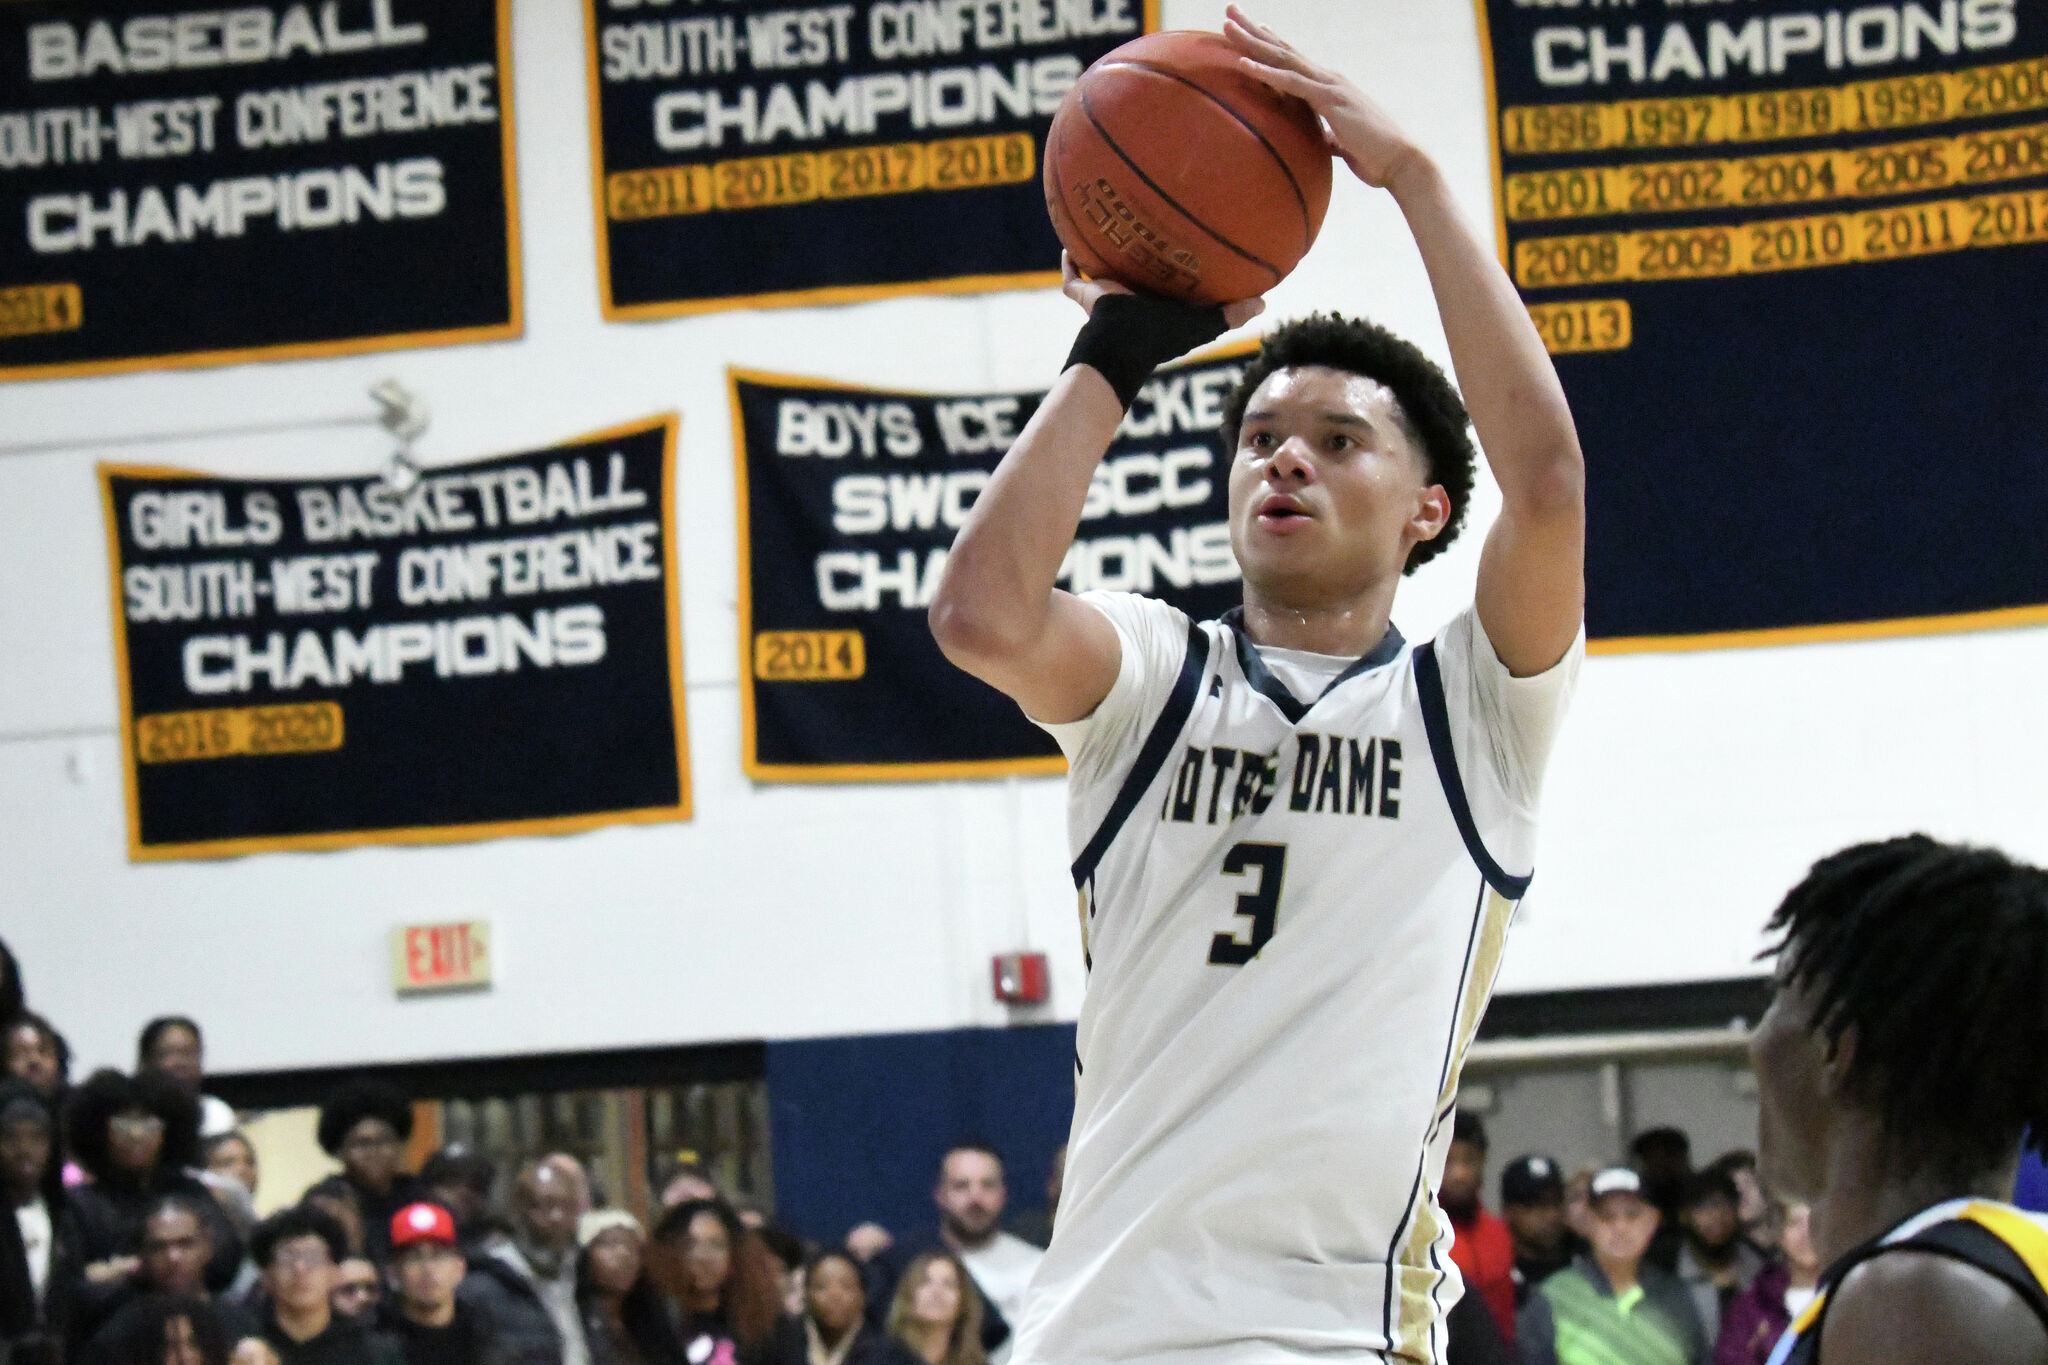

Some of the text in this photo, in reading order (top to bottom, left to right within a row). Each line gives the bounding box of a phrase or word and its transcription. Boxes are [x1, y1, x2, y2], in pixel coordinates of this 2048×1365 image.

[28, 0, 428, 80] BASEBALL
[602, 0, 1138, 81] SOUTH-WEST CONFERENCE
[1532, 0, 2017, 86] CHAMPIONS
[236, 63, 499, 148] CONFERENCE
[653, 55, 1084, 150] CHAMPIONS
[1513, 105, 1602, 148] 1996
[1624, 99, 1713, 143] 1997
[1856, 79, 1948, 128] 1999
[27, 157, 447, 253] CHAMPIONS
[614, 138, 1027, 214] 2011 2016 2017 2018
[1514, 172, 1608, 216] 2001
[1628, 162, 1725, 208] 2002
[1740, 155, 1838, 201] 2004
[1854, 142, 1948, 188] 2005
[1522, 238, 1620, 283] 2008
[1637, 228, 1733, 273] 2009
[1750, 219, 1844, 265] 2010
[1863, 208, 1956, 254] 2011
[775, 399, 922, 459] BOYS
[934, 395, 1019, 458] ICE
[129, 452, 648, 550] GIRLS BASKETBALL
[122, 521, 662, 622] SOUTH-WEST CONFERENCE
[182, 603, 607, 695] CHAMPIONS
[766, 635, 854, 674] 2014
[148, 710, 231, 754] 2016
[1162, 733, 1404, 825] OTRE DAME
[1206, 840, 1288, 967] 3
[405, 922, 472, 983] EXIT
